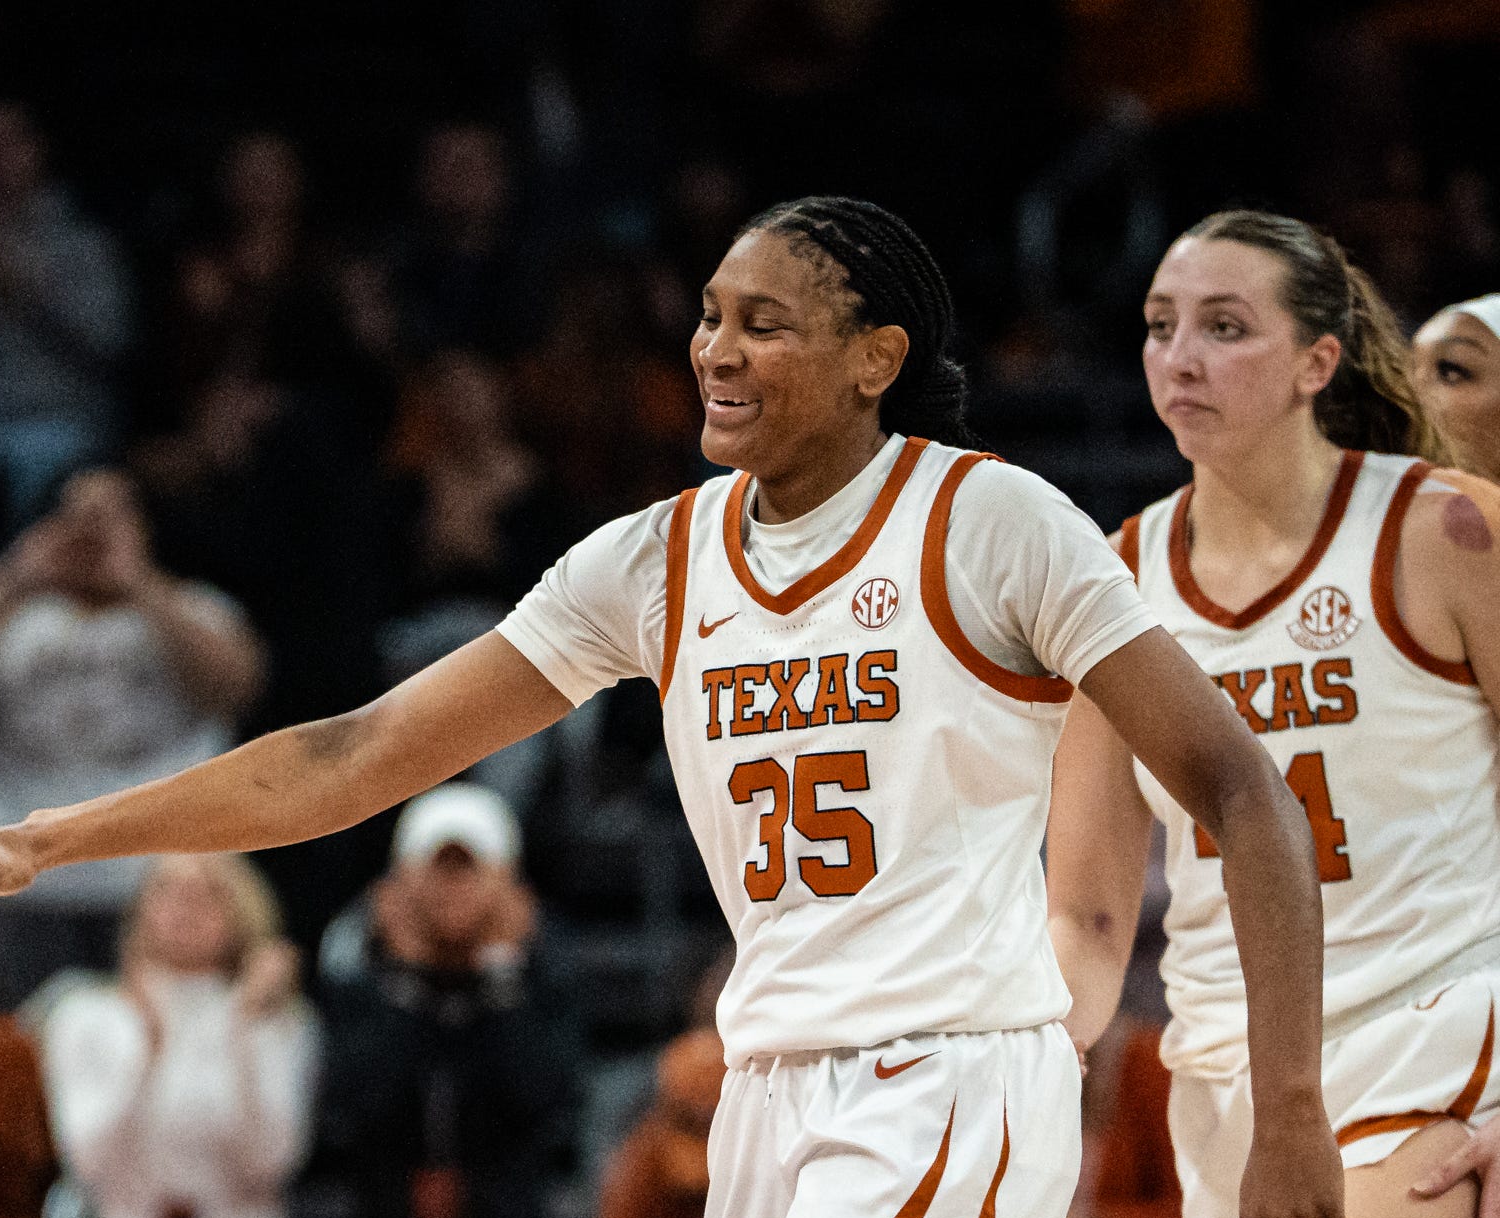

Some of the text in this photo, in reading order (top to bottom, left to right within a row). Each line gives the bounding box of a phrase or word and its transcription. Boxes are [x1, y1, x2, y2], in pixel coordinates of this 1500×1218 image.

[853, 578, 898, 628] SEC
[1303, 588, 1349, 635] SEC
[702, 649, 900, 741] TEXAS
[1210, 657, 1359, 735] XAS
[728, 750, 878, 902] 35
